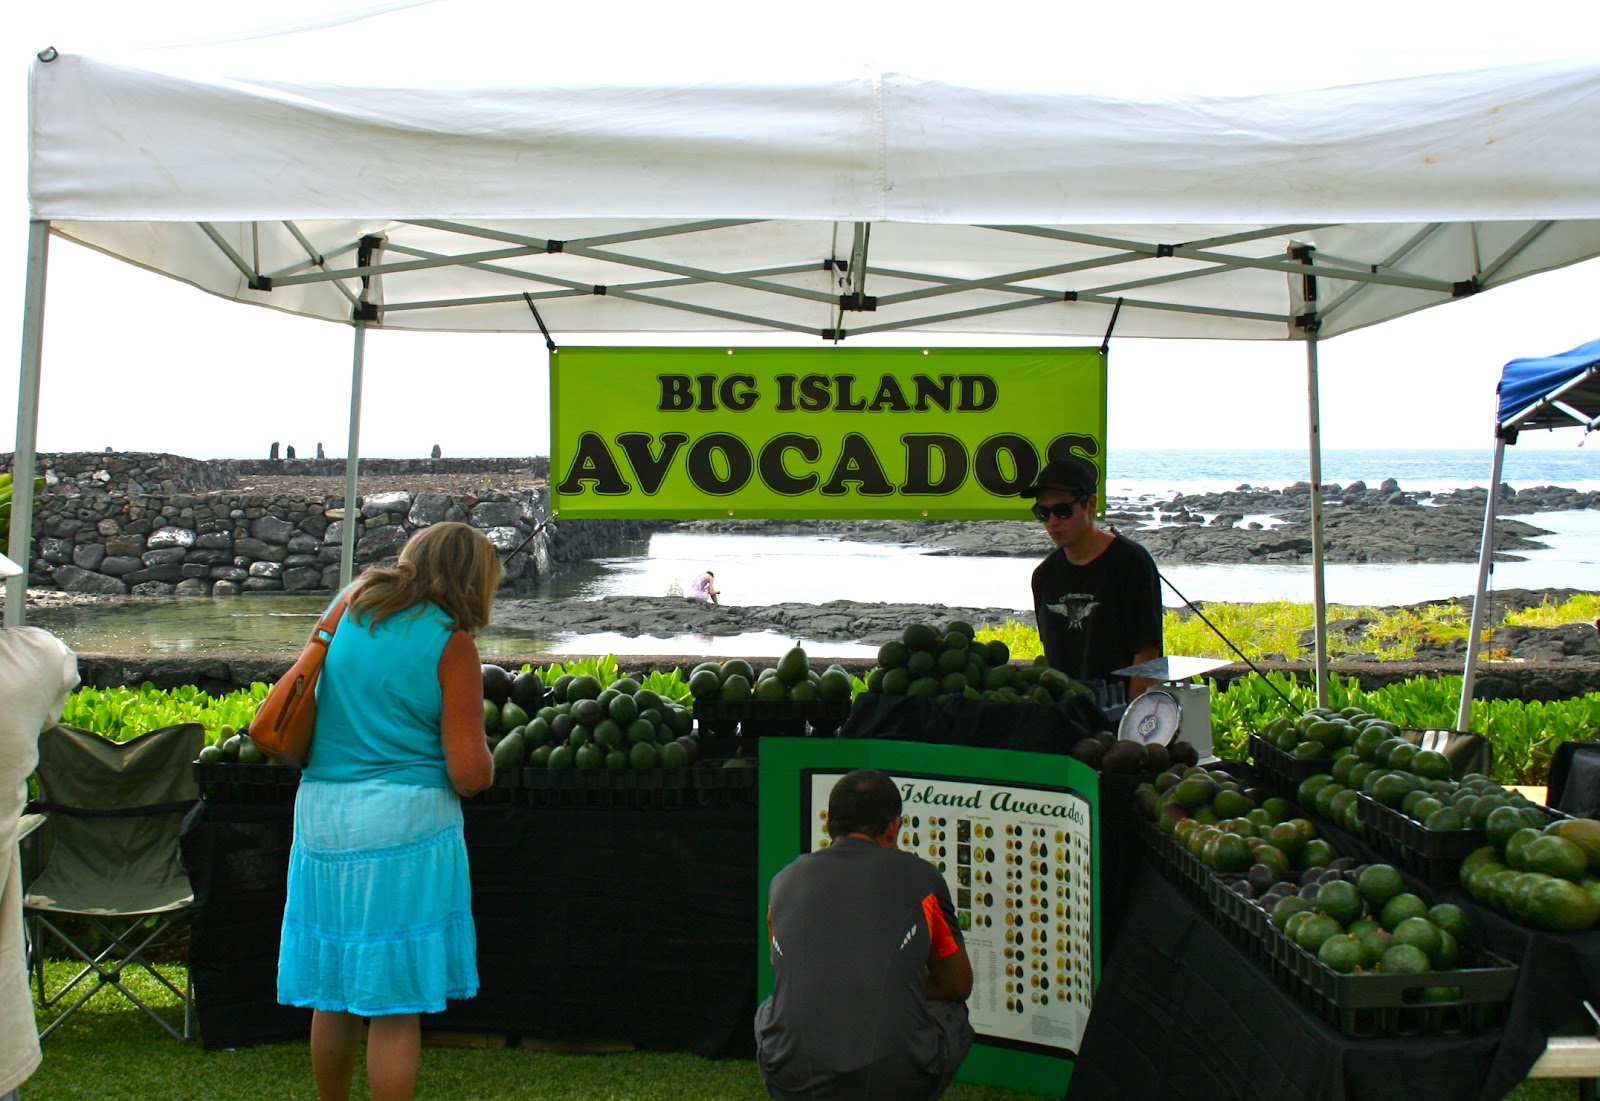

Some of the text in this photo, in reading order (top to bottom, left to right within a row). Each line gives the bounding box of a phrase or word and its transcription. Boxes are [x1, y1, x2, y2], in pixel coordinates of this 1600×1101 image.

[657, 373, 999, 414] BIG ISLAND
[556, 430, 1100, 497] AVOCADOS
[901, 783, 1084, 826] Island Avocados
